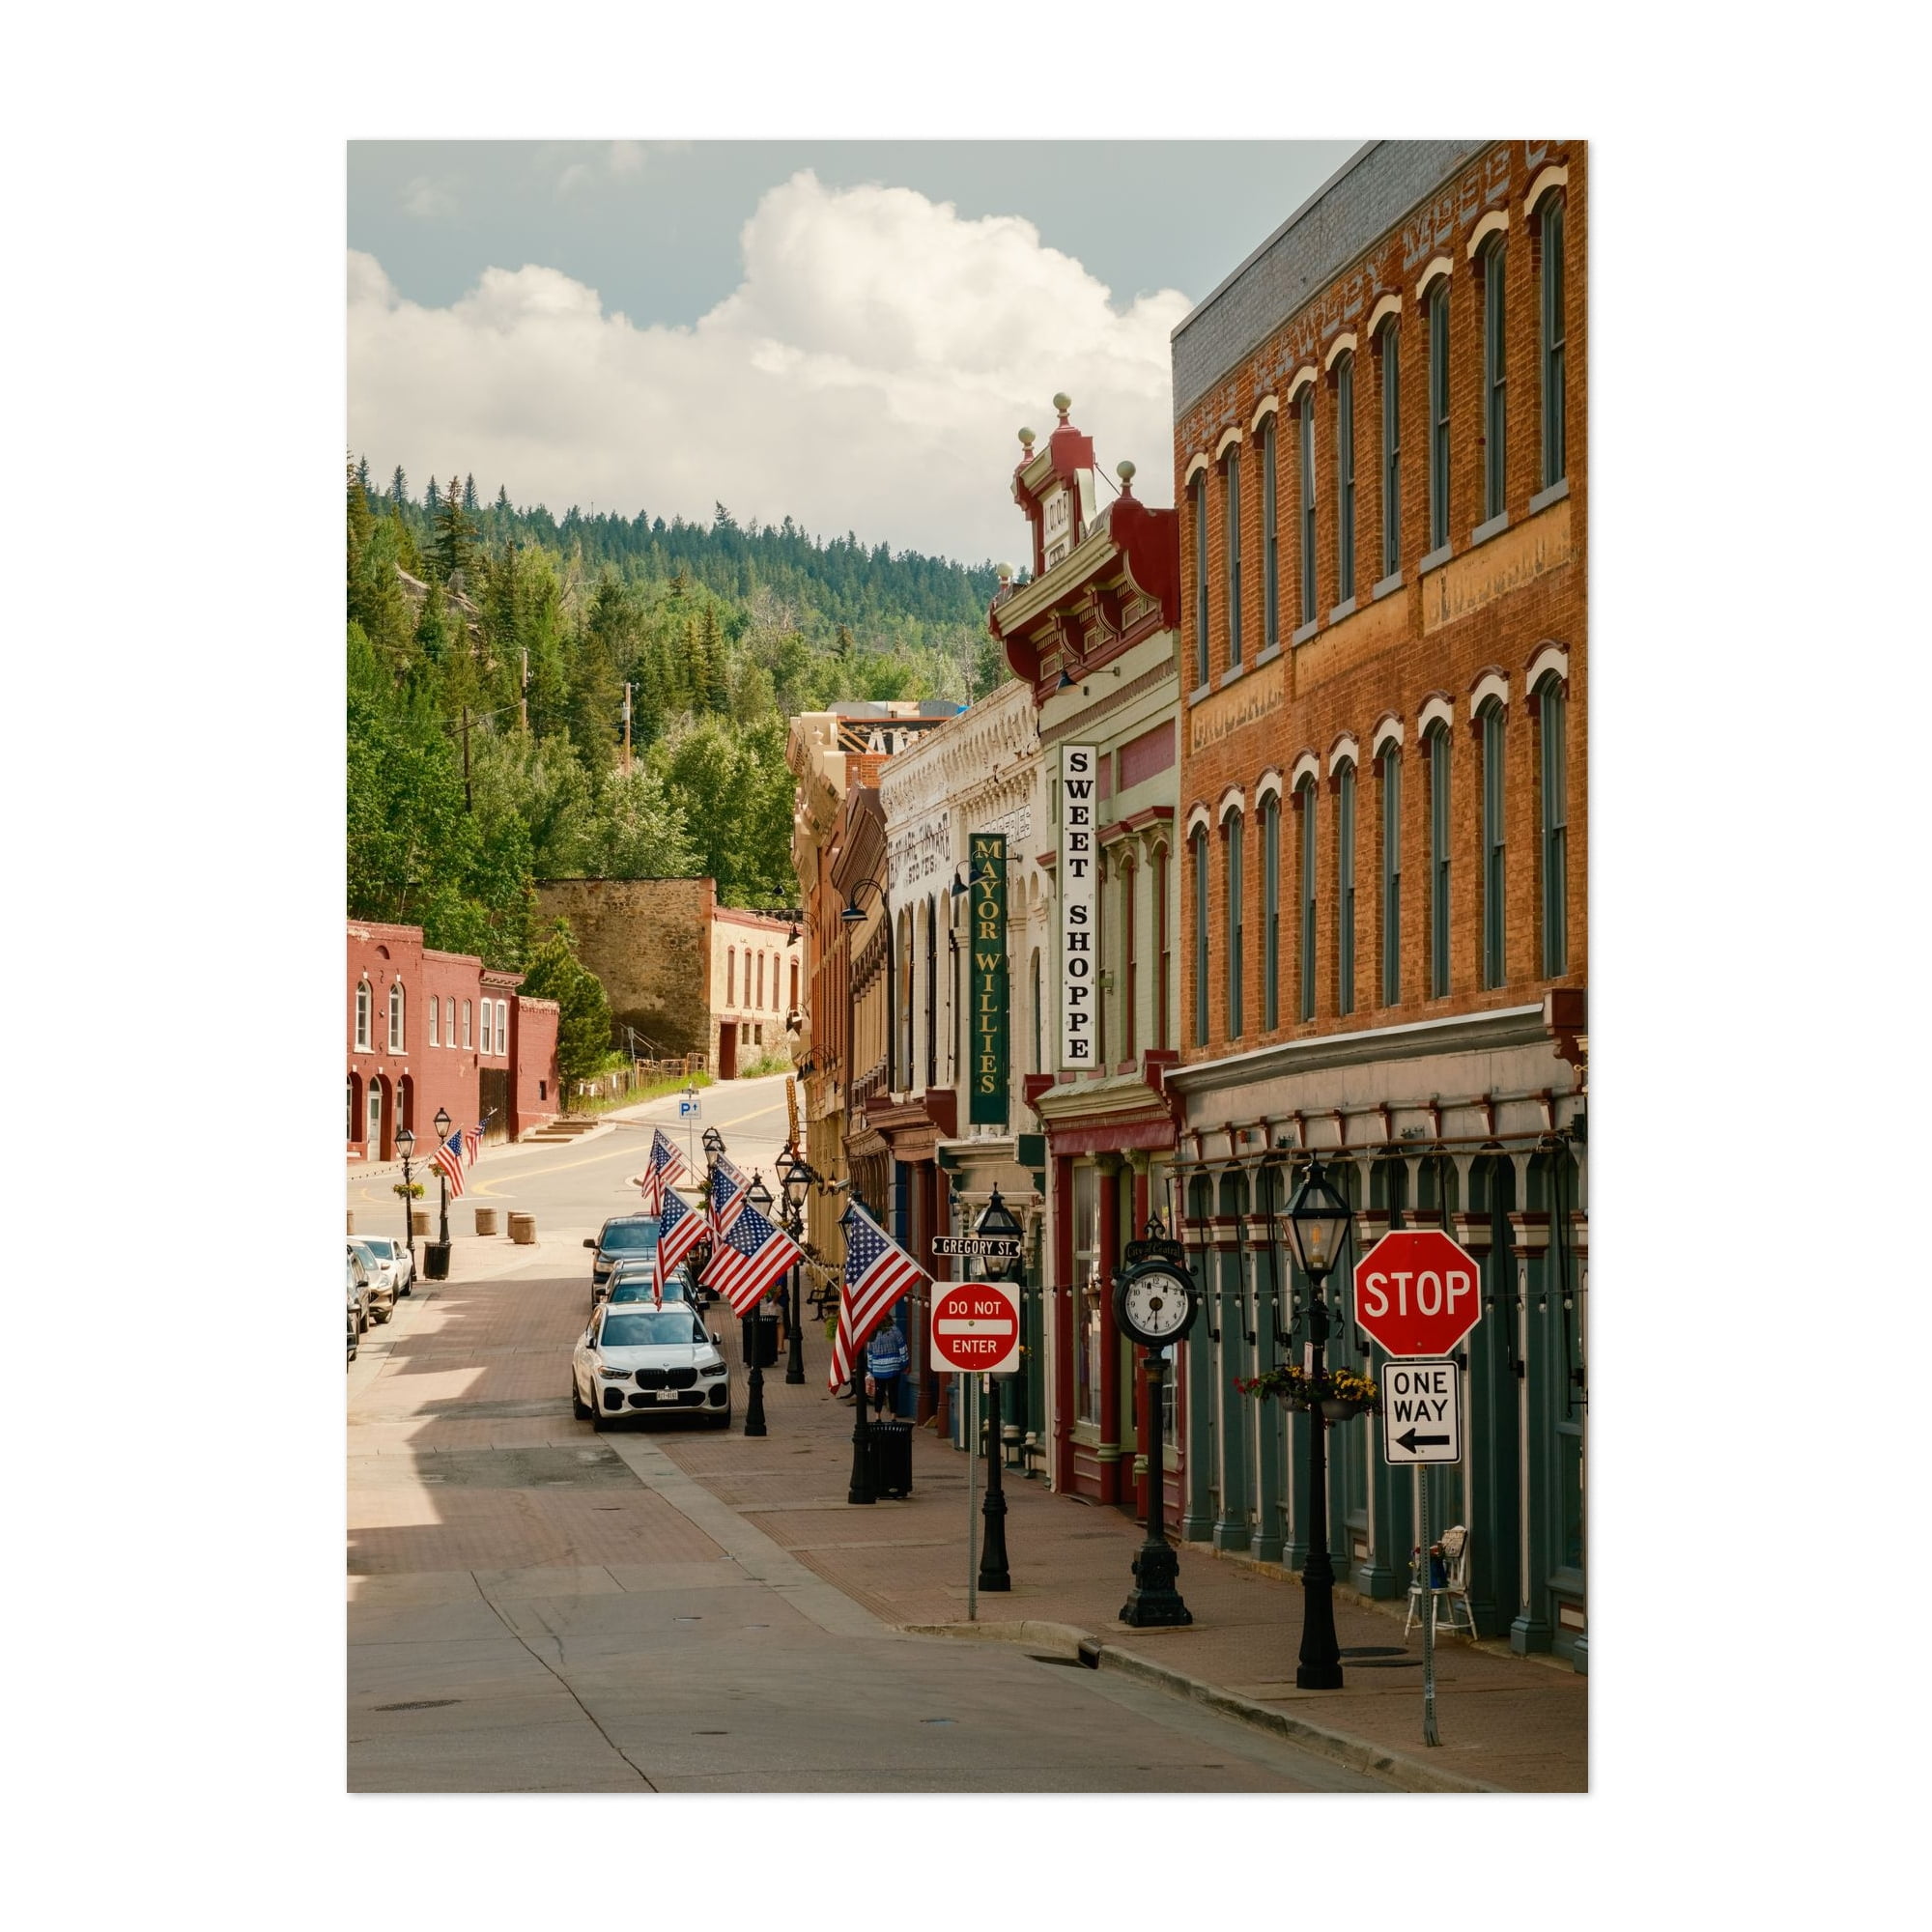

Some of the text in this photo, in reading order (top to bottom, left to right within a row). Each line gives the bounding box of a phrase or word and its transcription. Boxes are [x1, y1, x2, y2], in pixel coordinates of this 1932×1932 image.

[1065, 753, 1094, 1059] SWEET SHOPPE
[975, 840, 1003, 1094] MAYOR WILLIES
[943, 1237, 1013, 1257] GREGORY ST.
[1364, 1270, 1471, 1318] STOP
[949, 1300, 1002, 1315] DO NOT
[952, 1340, 997, 1353] ENTER
[1394, 1371, 1448, 1395] ONE
[1393, 1399, 1449, 1423] WAY
